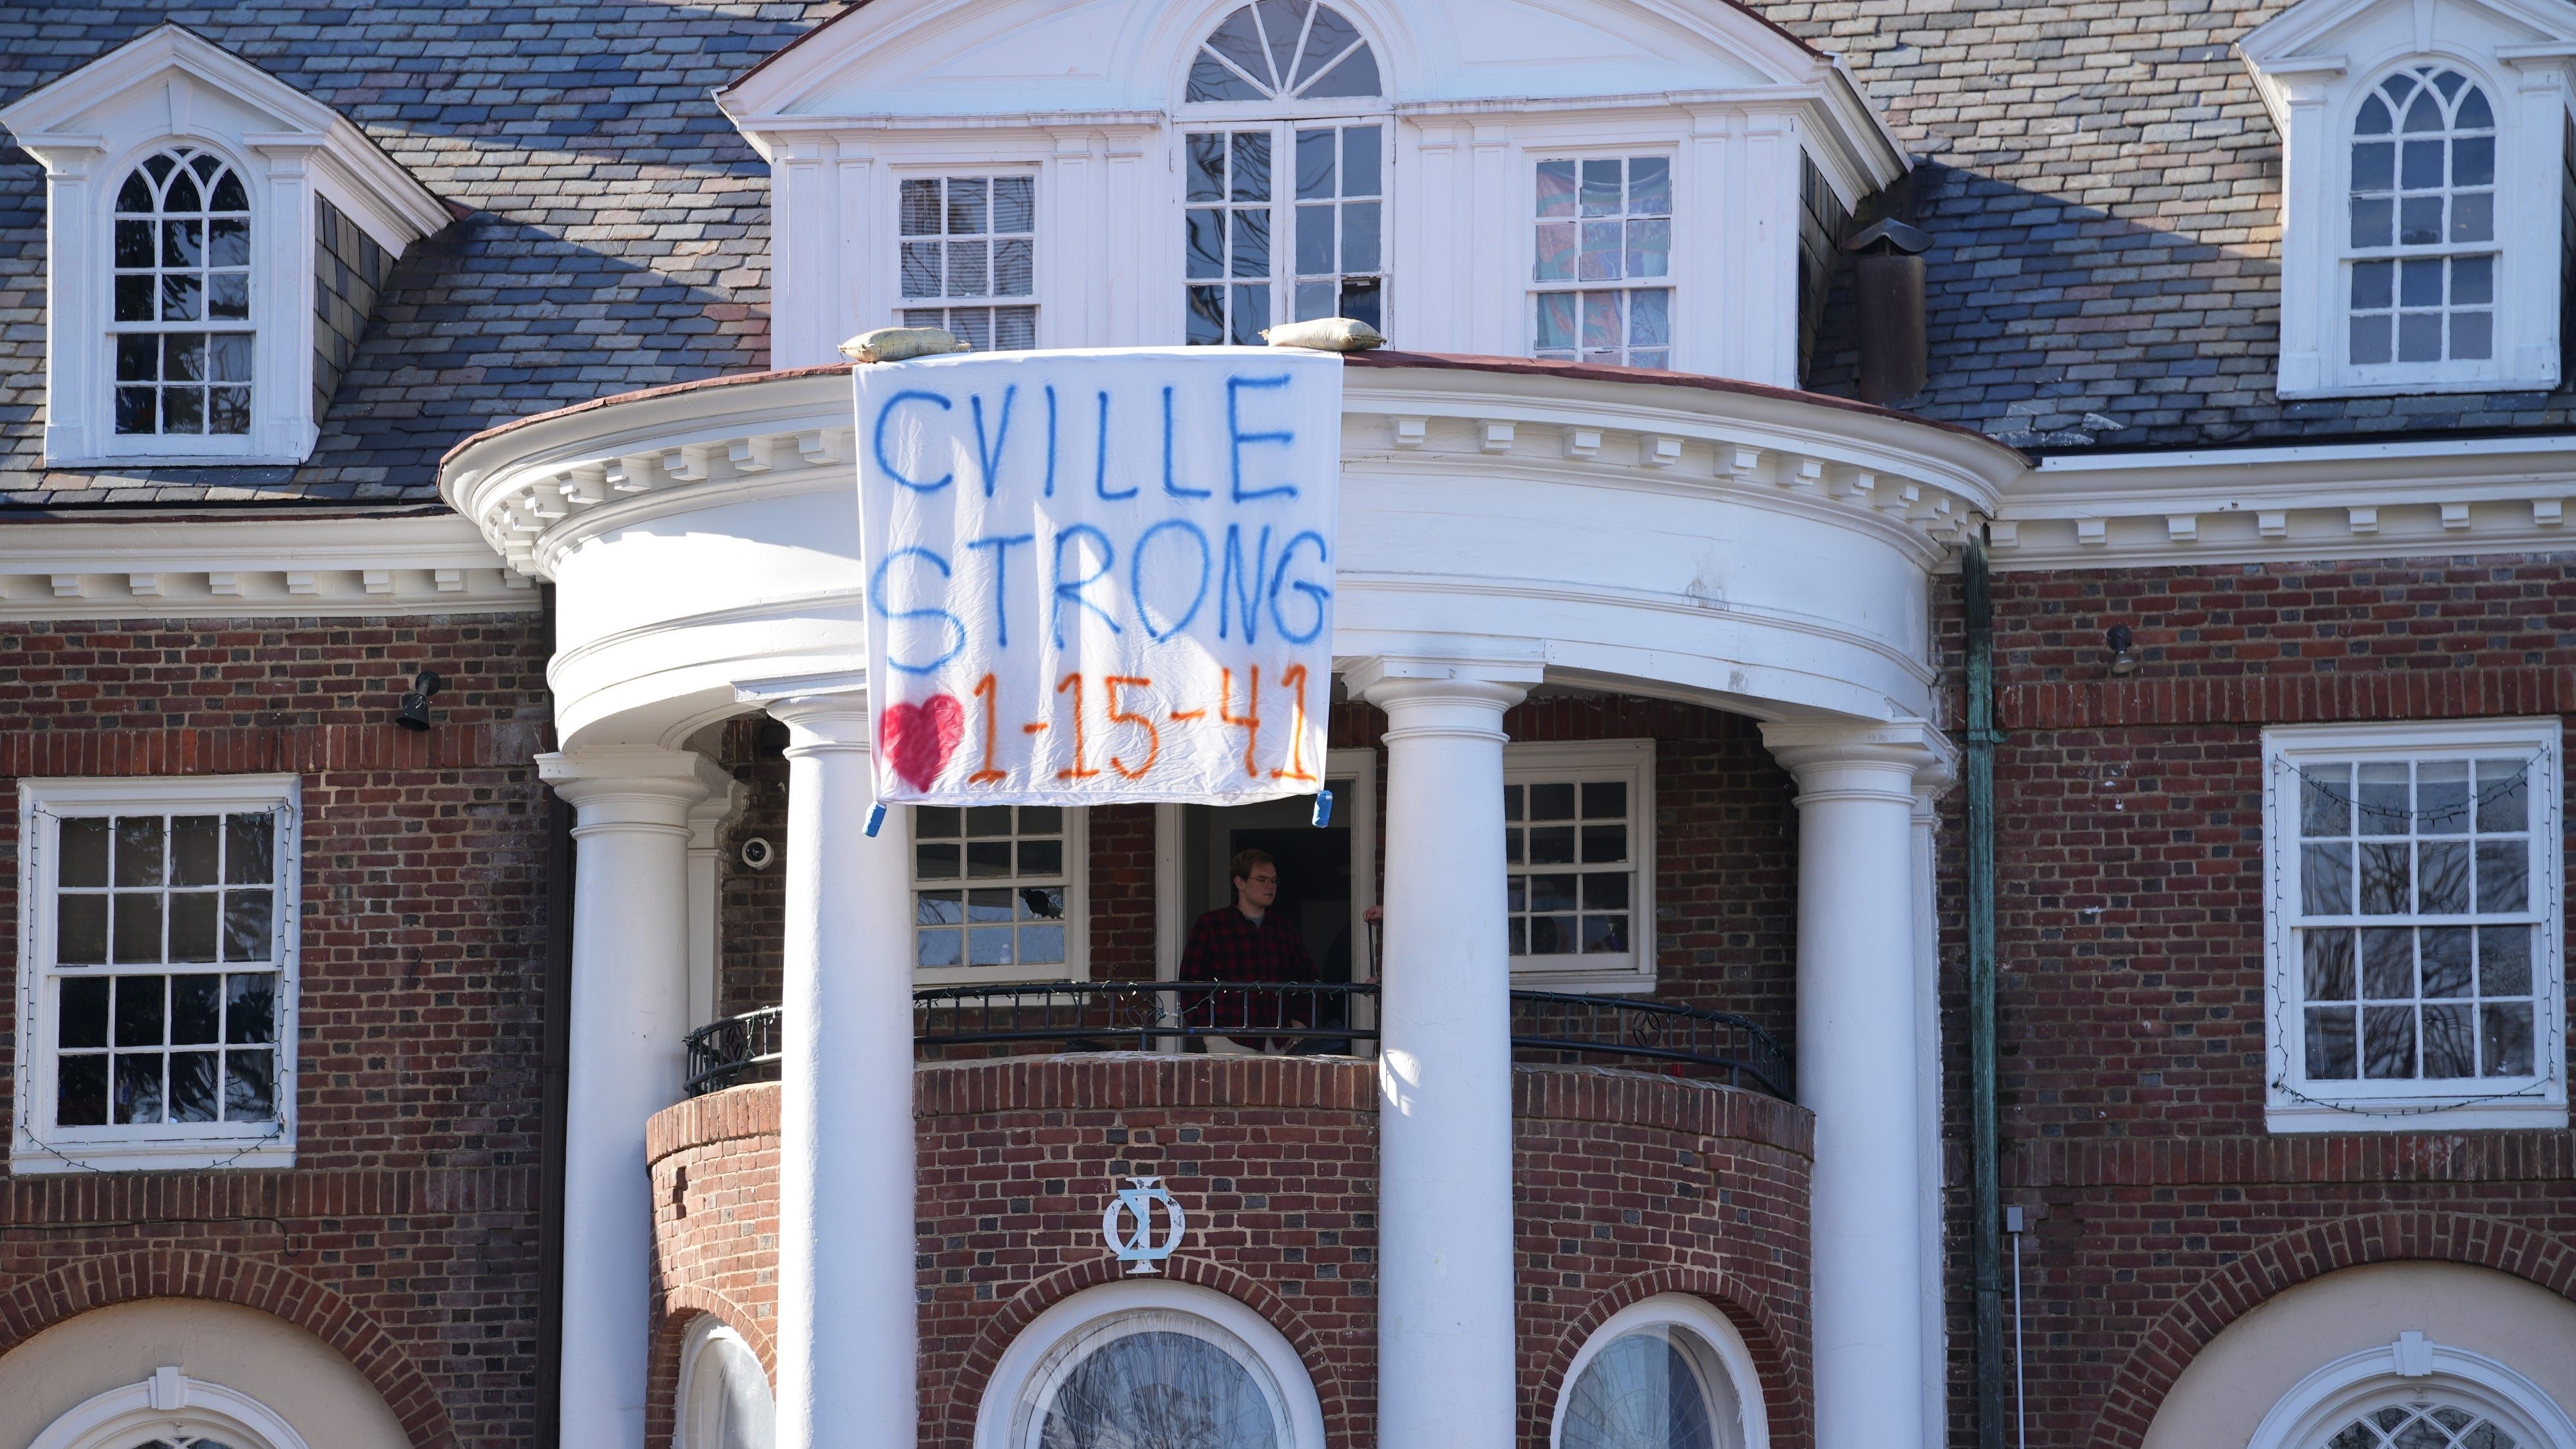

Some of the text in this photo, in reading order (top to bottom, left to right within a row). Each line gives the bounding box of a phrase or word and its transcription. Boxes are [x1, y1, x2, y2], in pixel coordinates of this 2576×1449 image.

[873, 374, 1299, 504] CVILLE
[869, 518, 1329, 676] STRONG
[968, 663, 1317, 784] 1-15-41
